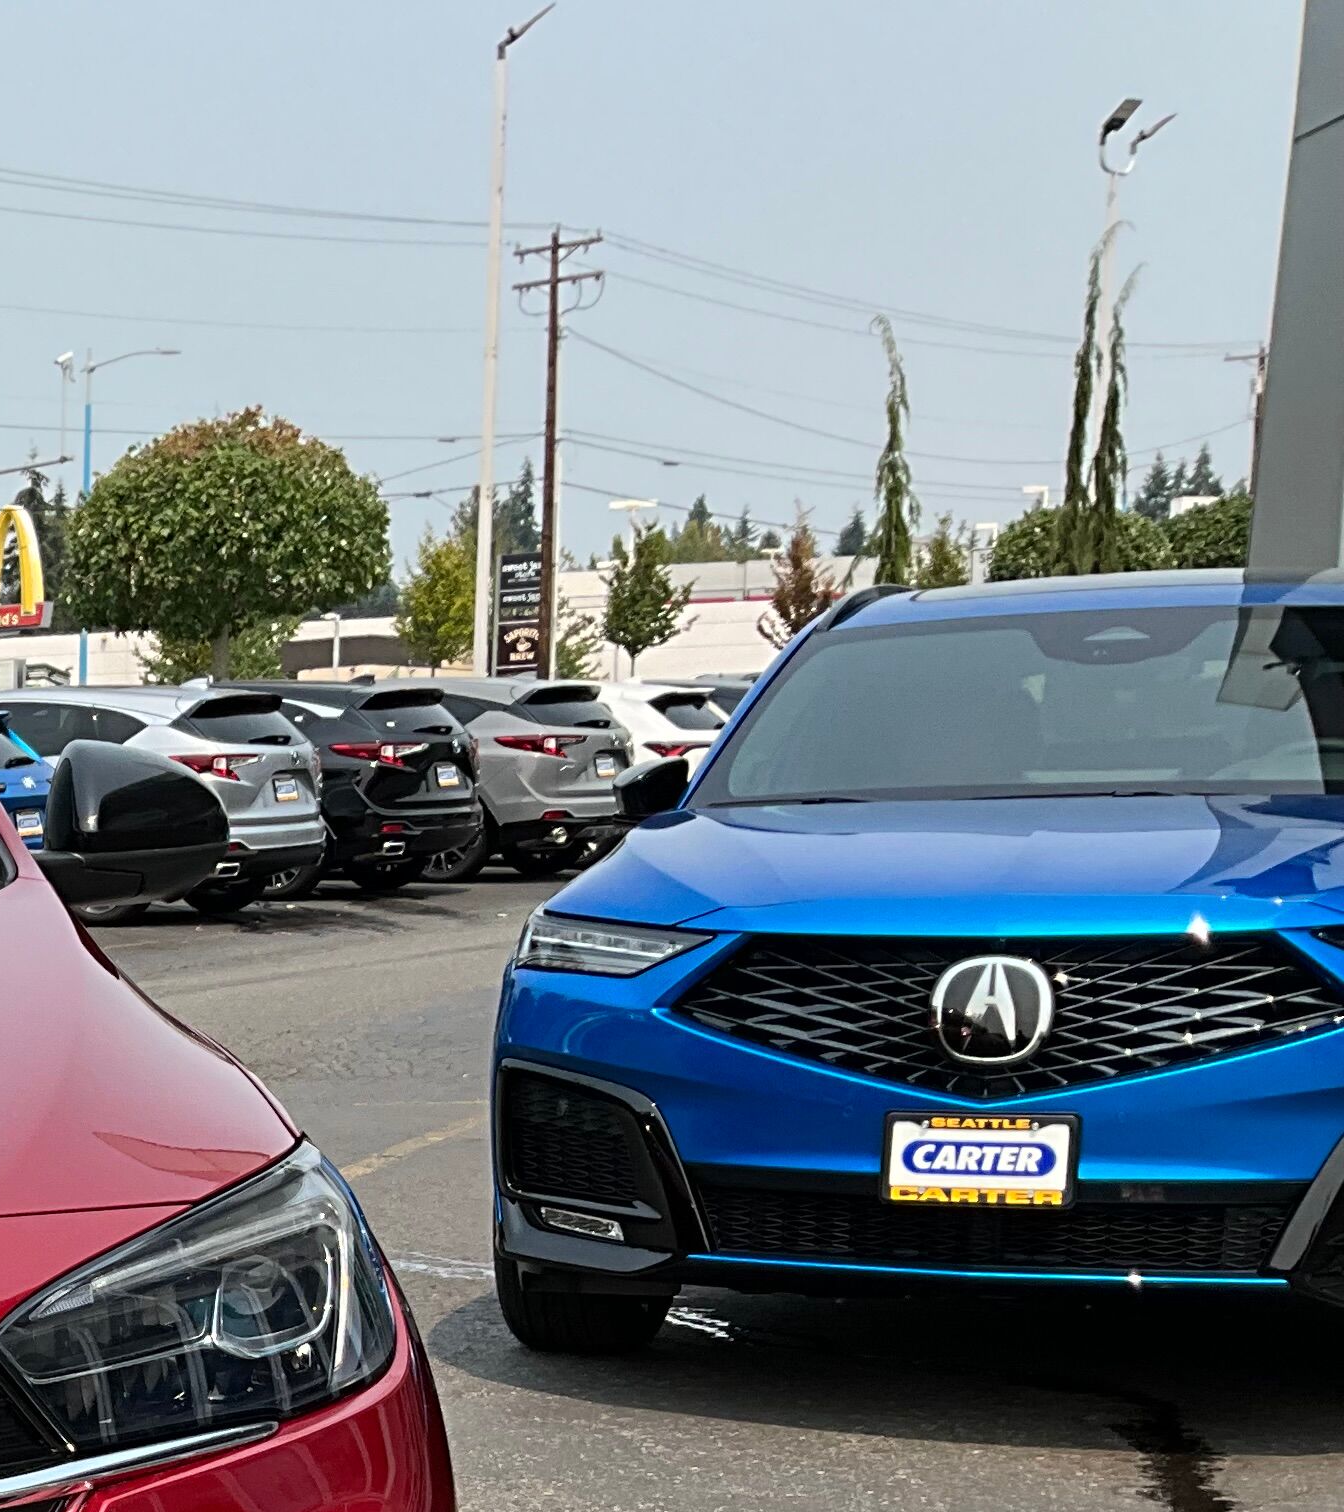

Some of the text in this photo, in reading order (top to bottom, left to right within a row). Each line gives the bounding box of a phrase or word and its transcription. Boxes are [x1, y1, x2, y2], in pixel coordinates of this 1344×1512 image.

[931, 1117, 1031, 1130] SEATTLE
[912, 1144, 1043, 1173] CARTER
[890, 1185, 1063, 1205] CARTER
